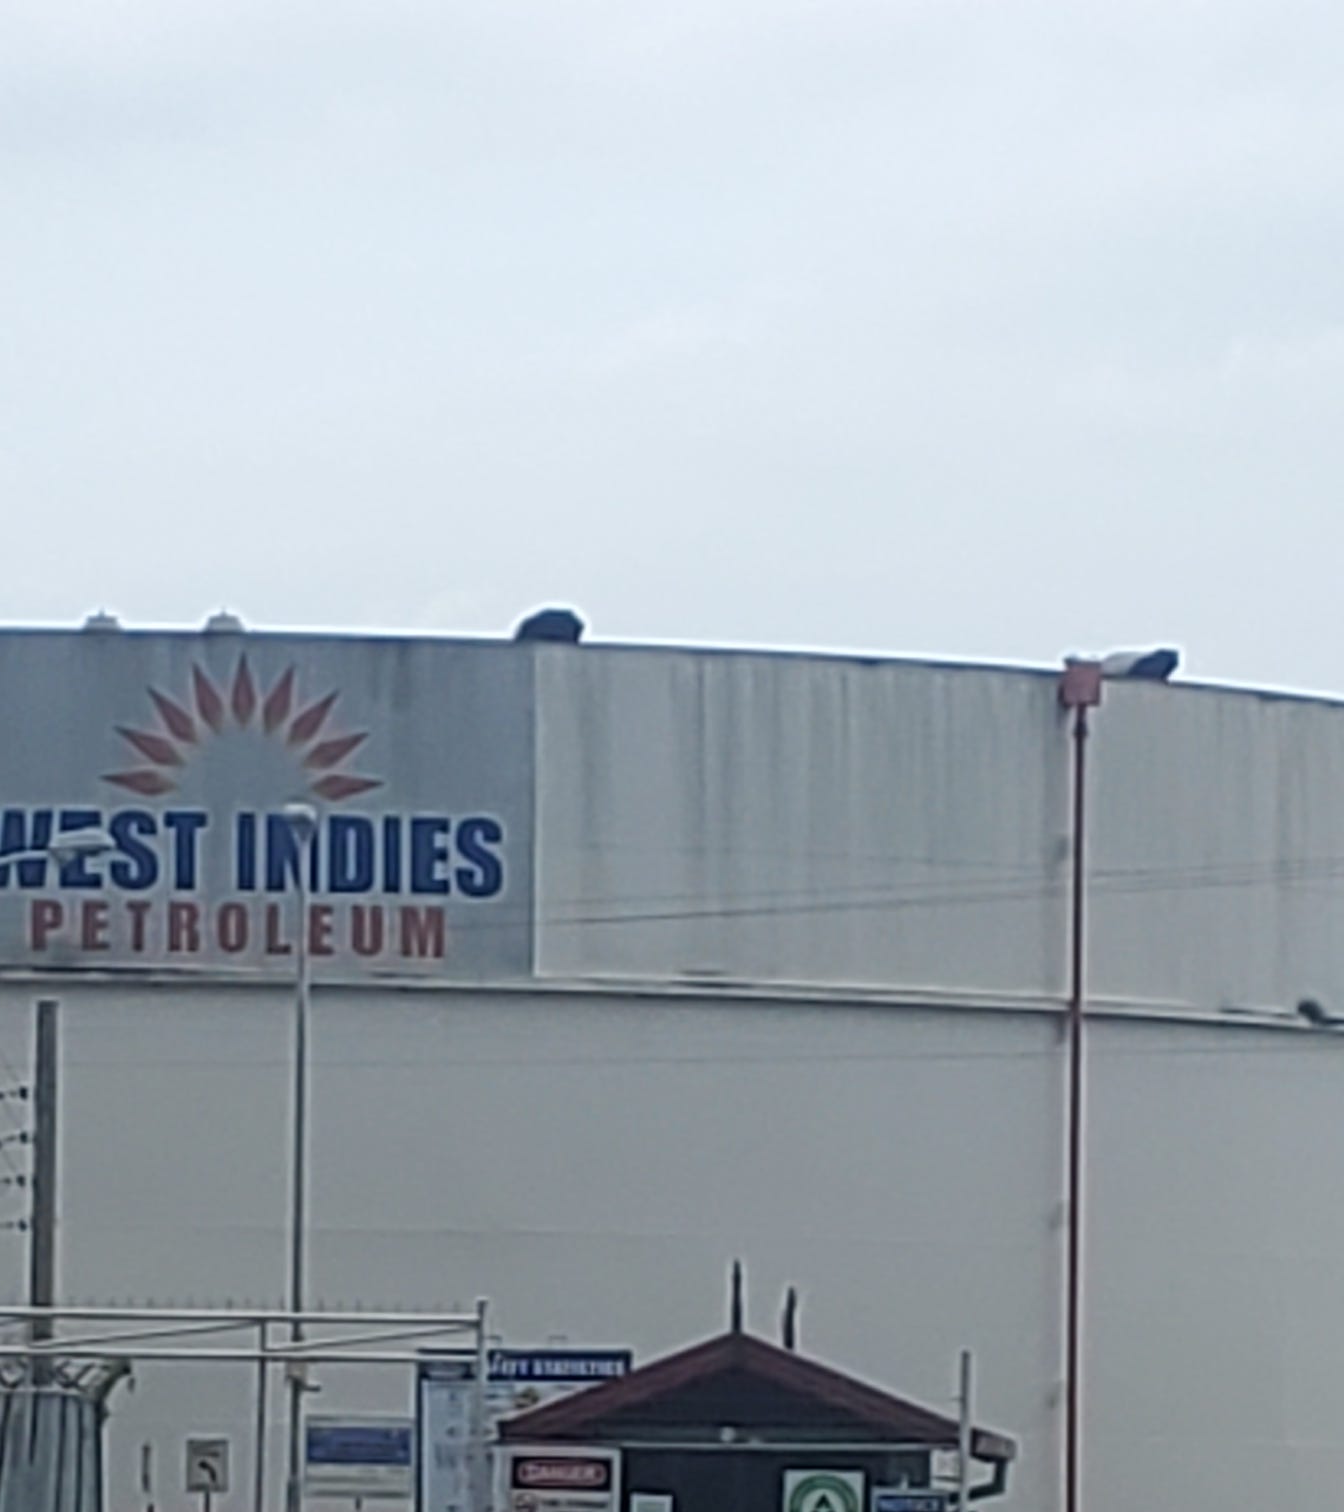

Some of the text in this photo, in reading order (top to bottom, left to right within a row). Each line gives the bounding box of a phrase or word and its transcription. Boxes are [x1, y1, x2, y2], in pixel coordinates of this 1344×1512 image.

[237, 811, 503, 898] INDIES
[31, 898, 445, 959] PETROLEUM
[526, 1462, 596, 1481] DANGER
